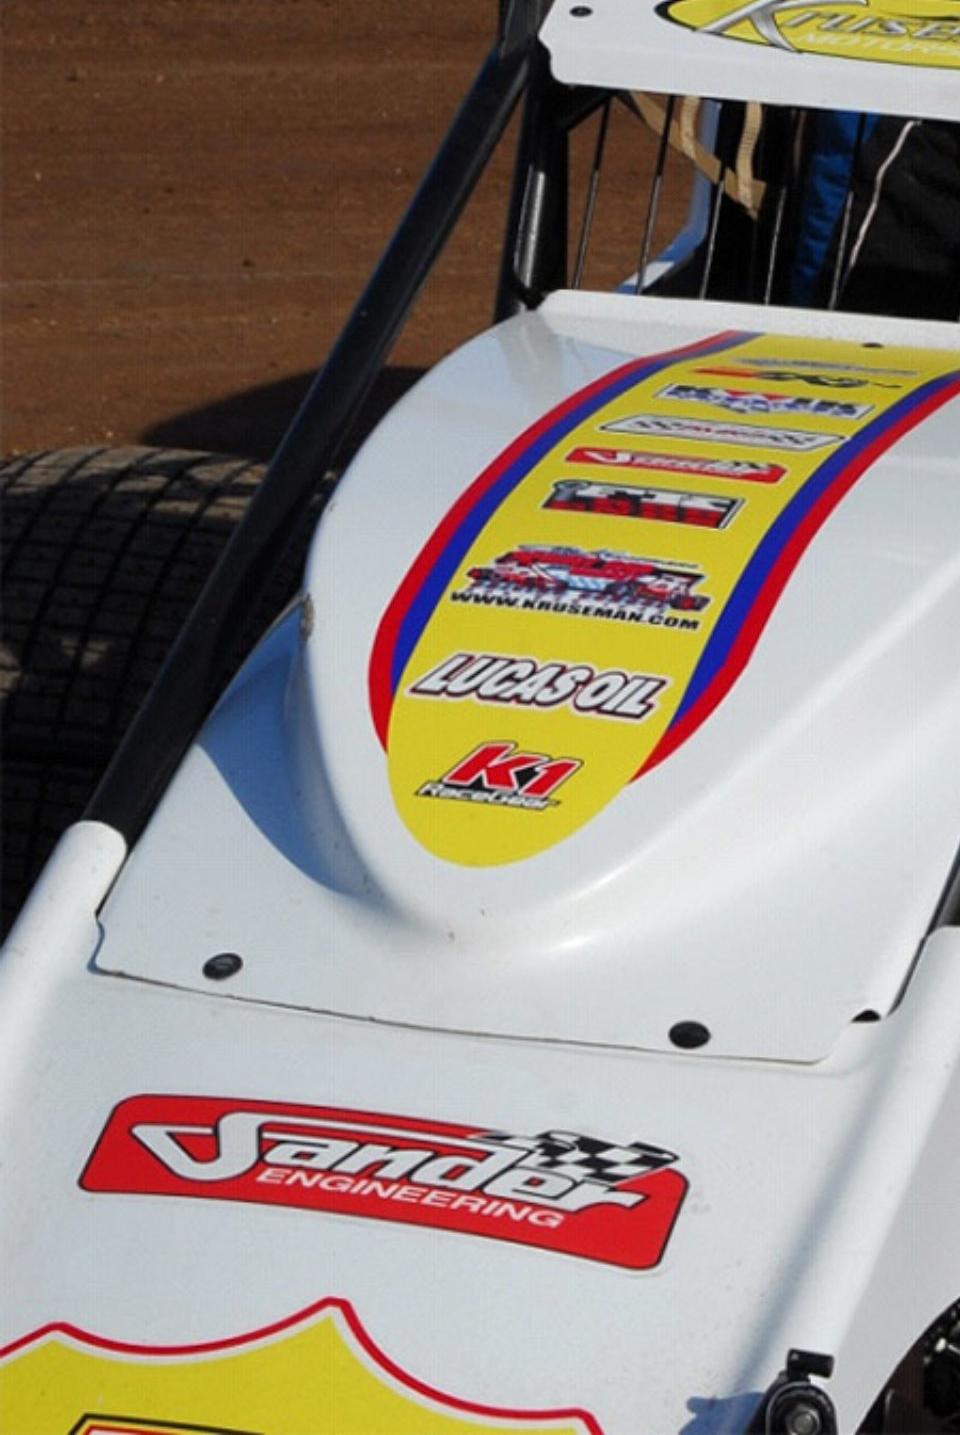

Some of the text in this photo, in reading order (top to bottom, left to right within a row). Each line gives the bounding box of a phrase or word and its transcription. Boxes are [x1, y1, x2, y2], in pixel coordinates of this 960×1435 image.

[450, 591, 700, 631] WWW.KRUSEMAN.COM
[410, 653, 668, 719] LUCAS OIL
[442, 741, 584, 799] K1
[130, 1111, 650, 1212] Sander
[255, 1167, 564, 1229] ENGINEERING
